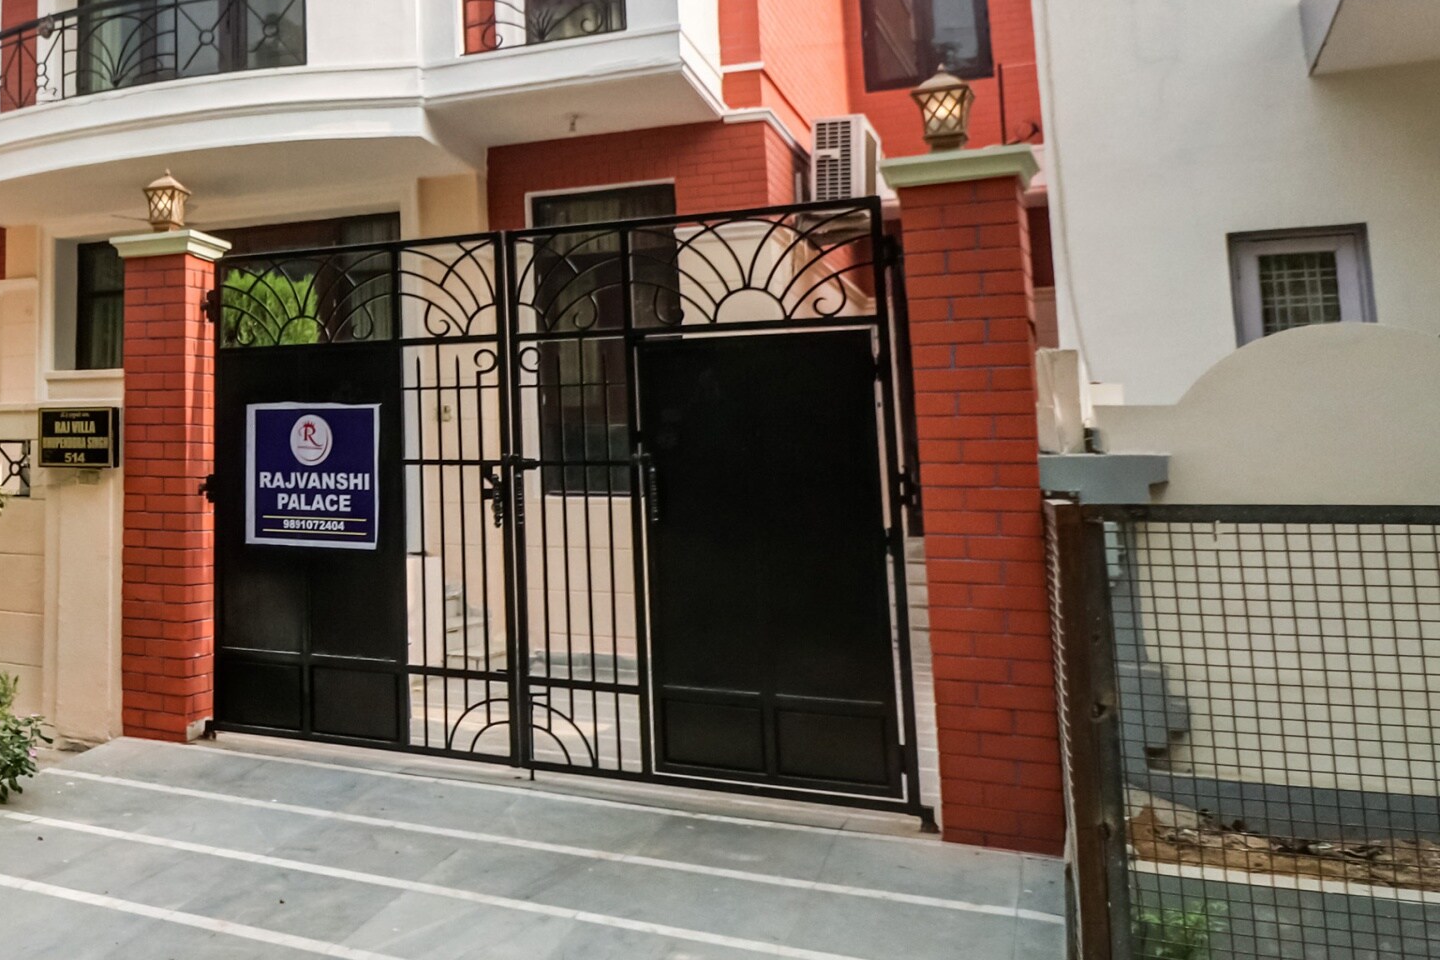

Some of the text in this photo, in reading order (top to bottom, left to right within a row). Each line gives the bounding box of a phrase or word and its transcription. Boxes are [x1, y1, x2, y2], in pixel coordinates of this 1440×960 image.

[64, 452, 86, 463] 514
[260, 471, 370, 491] RAJVANSHI
[277, 493, 352, 512] PALACE
[283, 519, 345, 531] 9891072404
